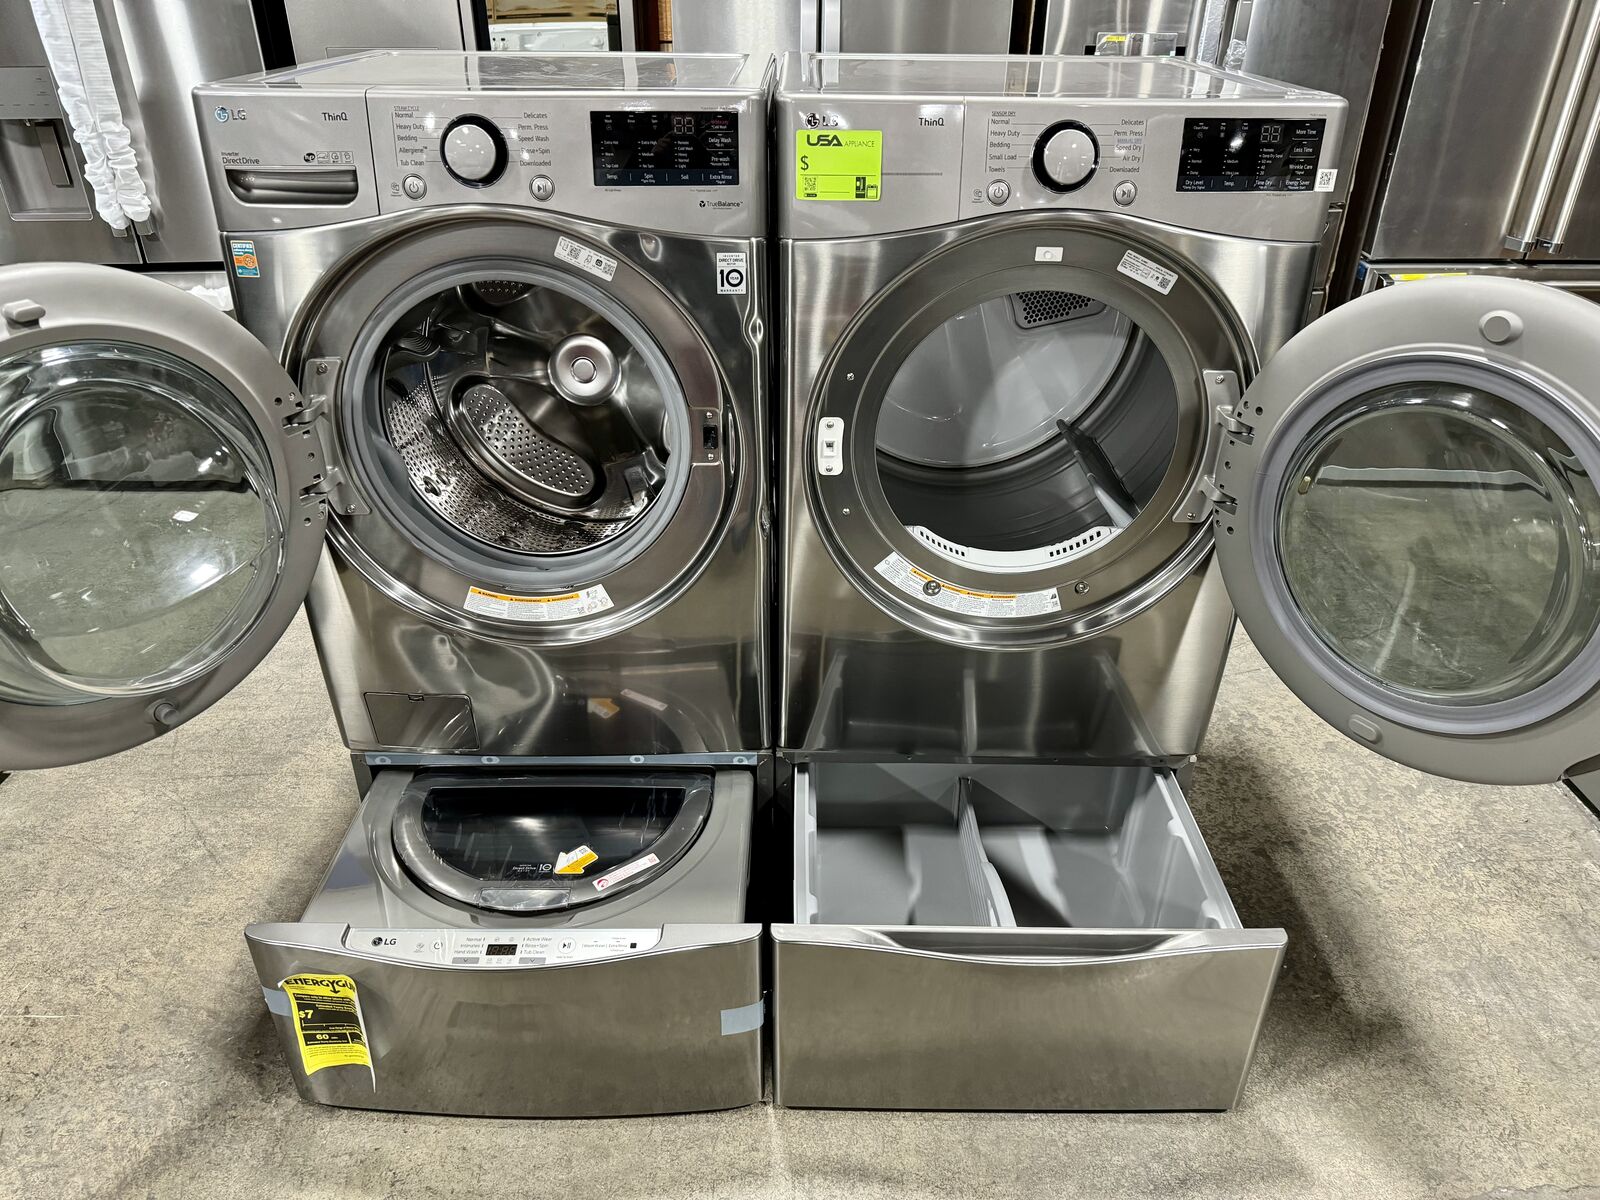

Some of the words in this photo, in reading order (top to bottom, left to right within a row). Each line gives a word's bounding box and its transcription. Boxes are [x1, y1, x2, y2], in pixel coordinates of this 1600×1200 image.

[231, 109, 246, 120] LG
[321, 112, 348, 121] ThinQ
[919, 118, 944, 127] ThinQ
[806, 134, 843, 146] USA
[800, 155, 809, 170] $
[720, 269, 744, 287] 10
[299, 1010, 313, 1018] $7
